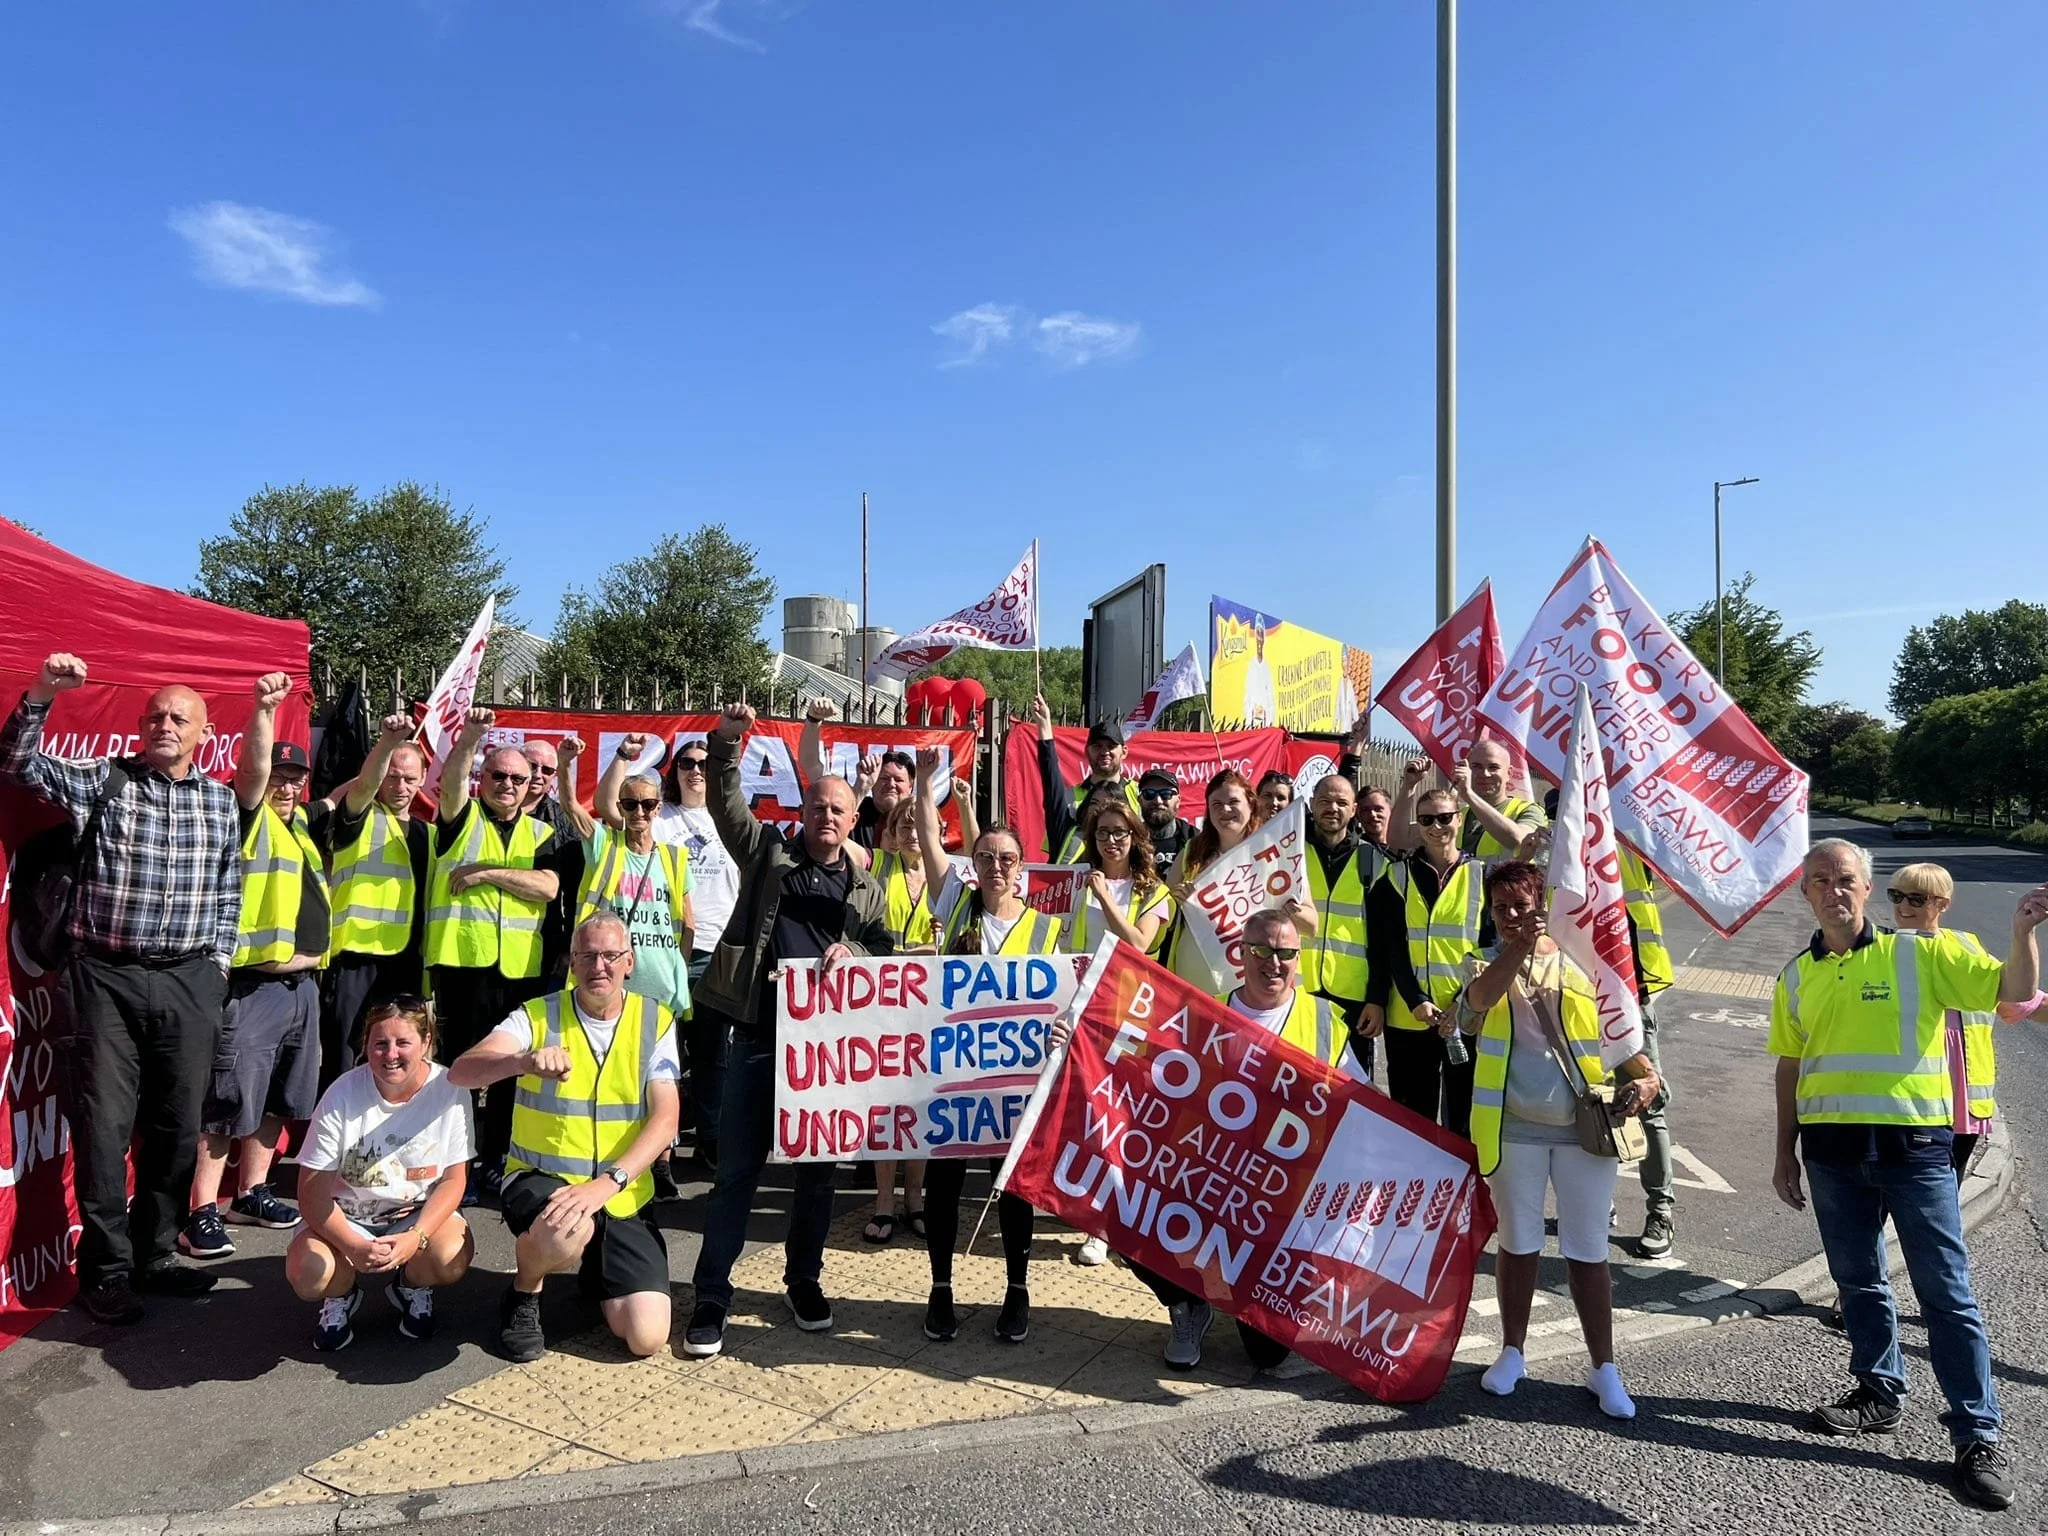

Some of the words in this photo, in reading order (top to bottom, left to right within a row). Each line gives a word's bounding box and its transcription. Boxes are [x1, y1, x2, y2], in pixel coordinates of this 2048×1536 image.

[1542, 635, 1597, 677] AND
[1598, 680, 1671, 743] ALLIED
[1560, 603, 1697, 726] FOOD
[1589, 583, 1718, 704] BAKERS
[1400, 679, 1472, 763] UNIO
[1525, 646, 1654, 763] WOKERS
[1620, 795, 1673, 845] STRENGTH
[1673, 841, 1686, 857] IN
[1685, 853, 1720, 884] UNITY
[1632, 775, 1743, 874] BFAWU
[652, 911, 660, 925] &
[1237, 864, 1265, 905] AND
[631, 932, 679, 949] EVERYO
[785, 962, 929, 1020] UNDER
[940, 959, 1058, 1010] PAID
[785, 1033, 928, 1091] UNDER
[930, 1019, 1051, 1074] PRESS
[1104, 1020, 1311, 1160] FOOD
[1128, 981, 1331, 1117] BAKERS
[779, 1104, 918, 1158] UNDER
[923, 1094, 1032, 1145] STAF
[1083, 1102, 1273, 1236] WORKERS
[1092, 1073, 1169, 1129] AND
[1178, 1124, 1288, 1196] ALLIED
[1053, 1141, 1255, 1286] UNION
[1251, 1284, 1330, 1338] STRENGTH
[1331, 1330, 1351, 1350] IN
[1352, 1342, 1399, 1376] UNITY
[1260, 1247, 1418, 1357] BFAWU
